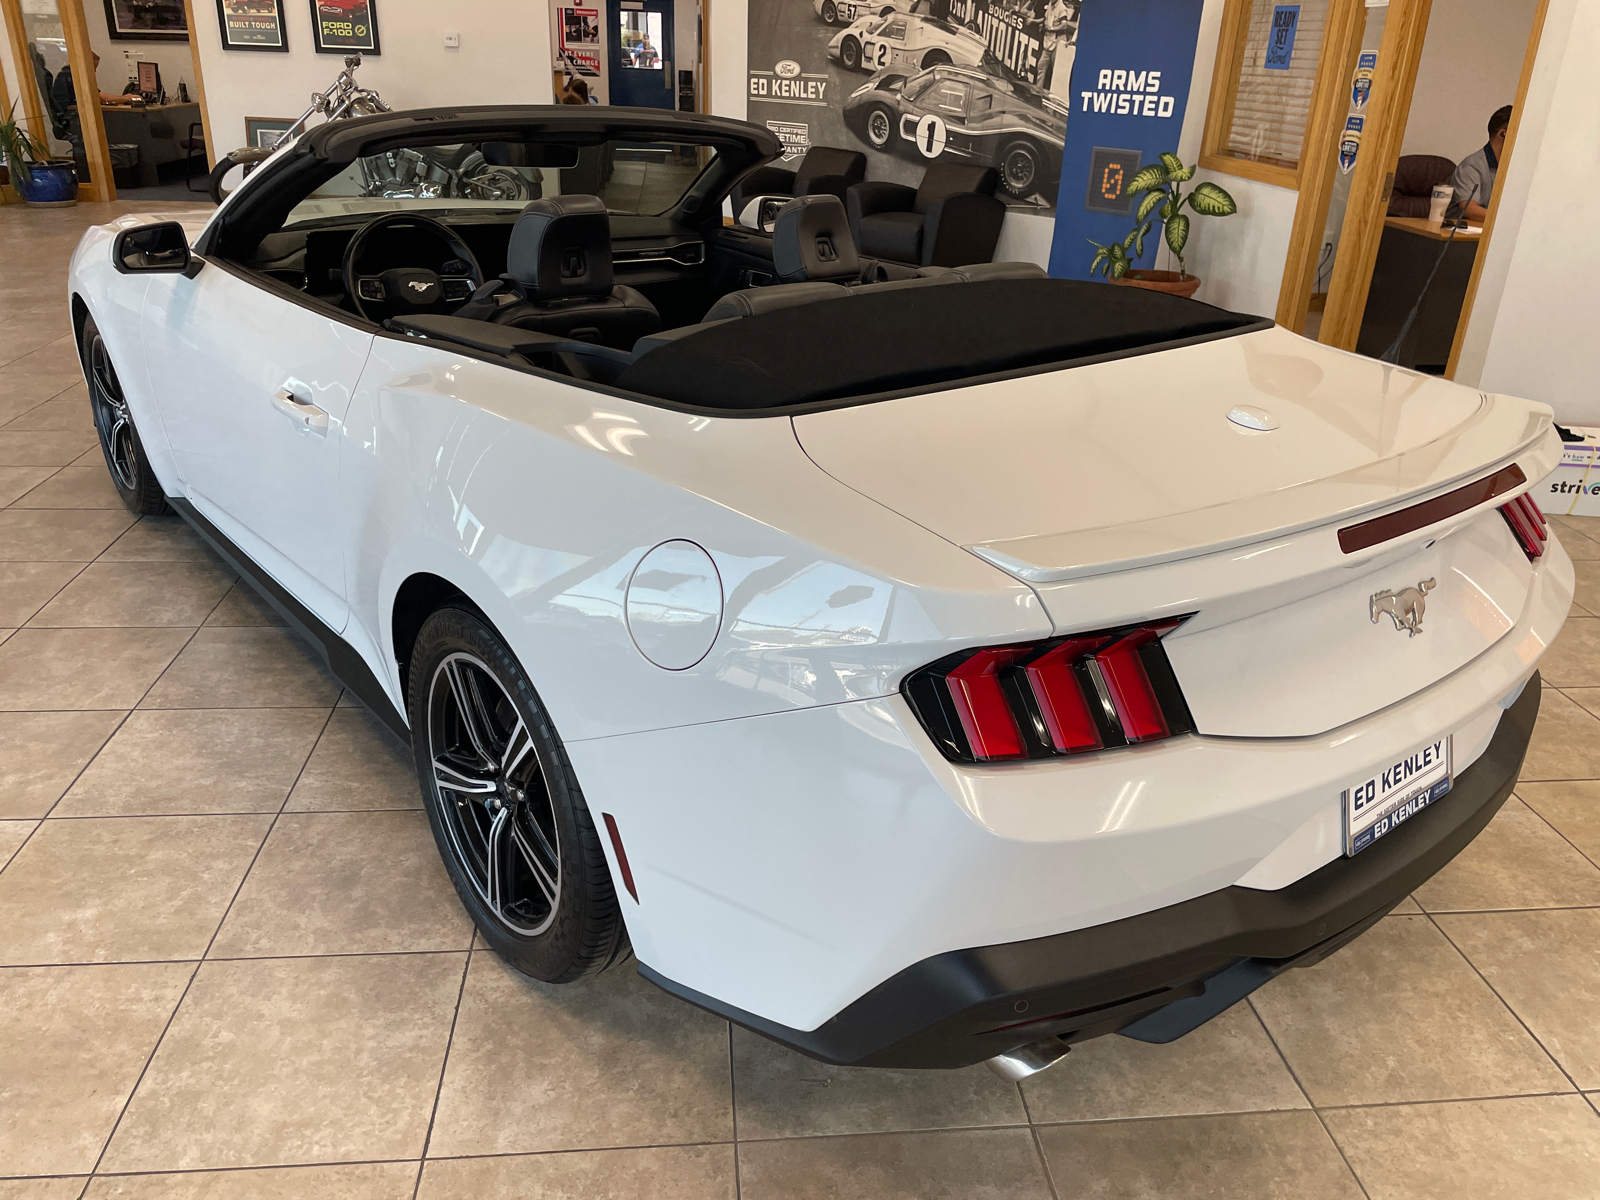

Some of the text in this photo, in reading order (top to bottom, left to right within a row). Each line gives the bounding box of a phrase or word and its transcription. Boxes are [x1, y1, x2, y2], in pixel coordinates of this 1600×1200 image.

[846, 3, 857, 20] 57
[1273, 10, 1298, 28] READY
[322, 21, 352, 29] FORD
[323, 28, 353, 37] F-100
[1275, 28, 1289, 46] SET
[877, 43, 887, 67] 2
[1267, 44, 1290, 65] Ford
[780, 63, 796, 75] Ford
[750, 78, 827, 99] ED KENLEY
[1097, 68, 1162, 93] ARMS
[1080, 91, 1175, 118] TWISTED
[926, 120, 937, 153] 1
[1101, 163, 1124, 200] 0
[1354, 740, 1441, 811] ED KENLEY
[1374, 818, 1389, 839] ED
[1391, 789, 1431, 827] KENLEY
